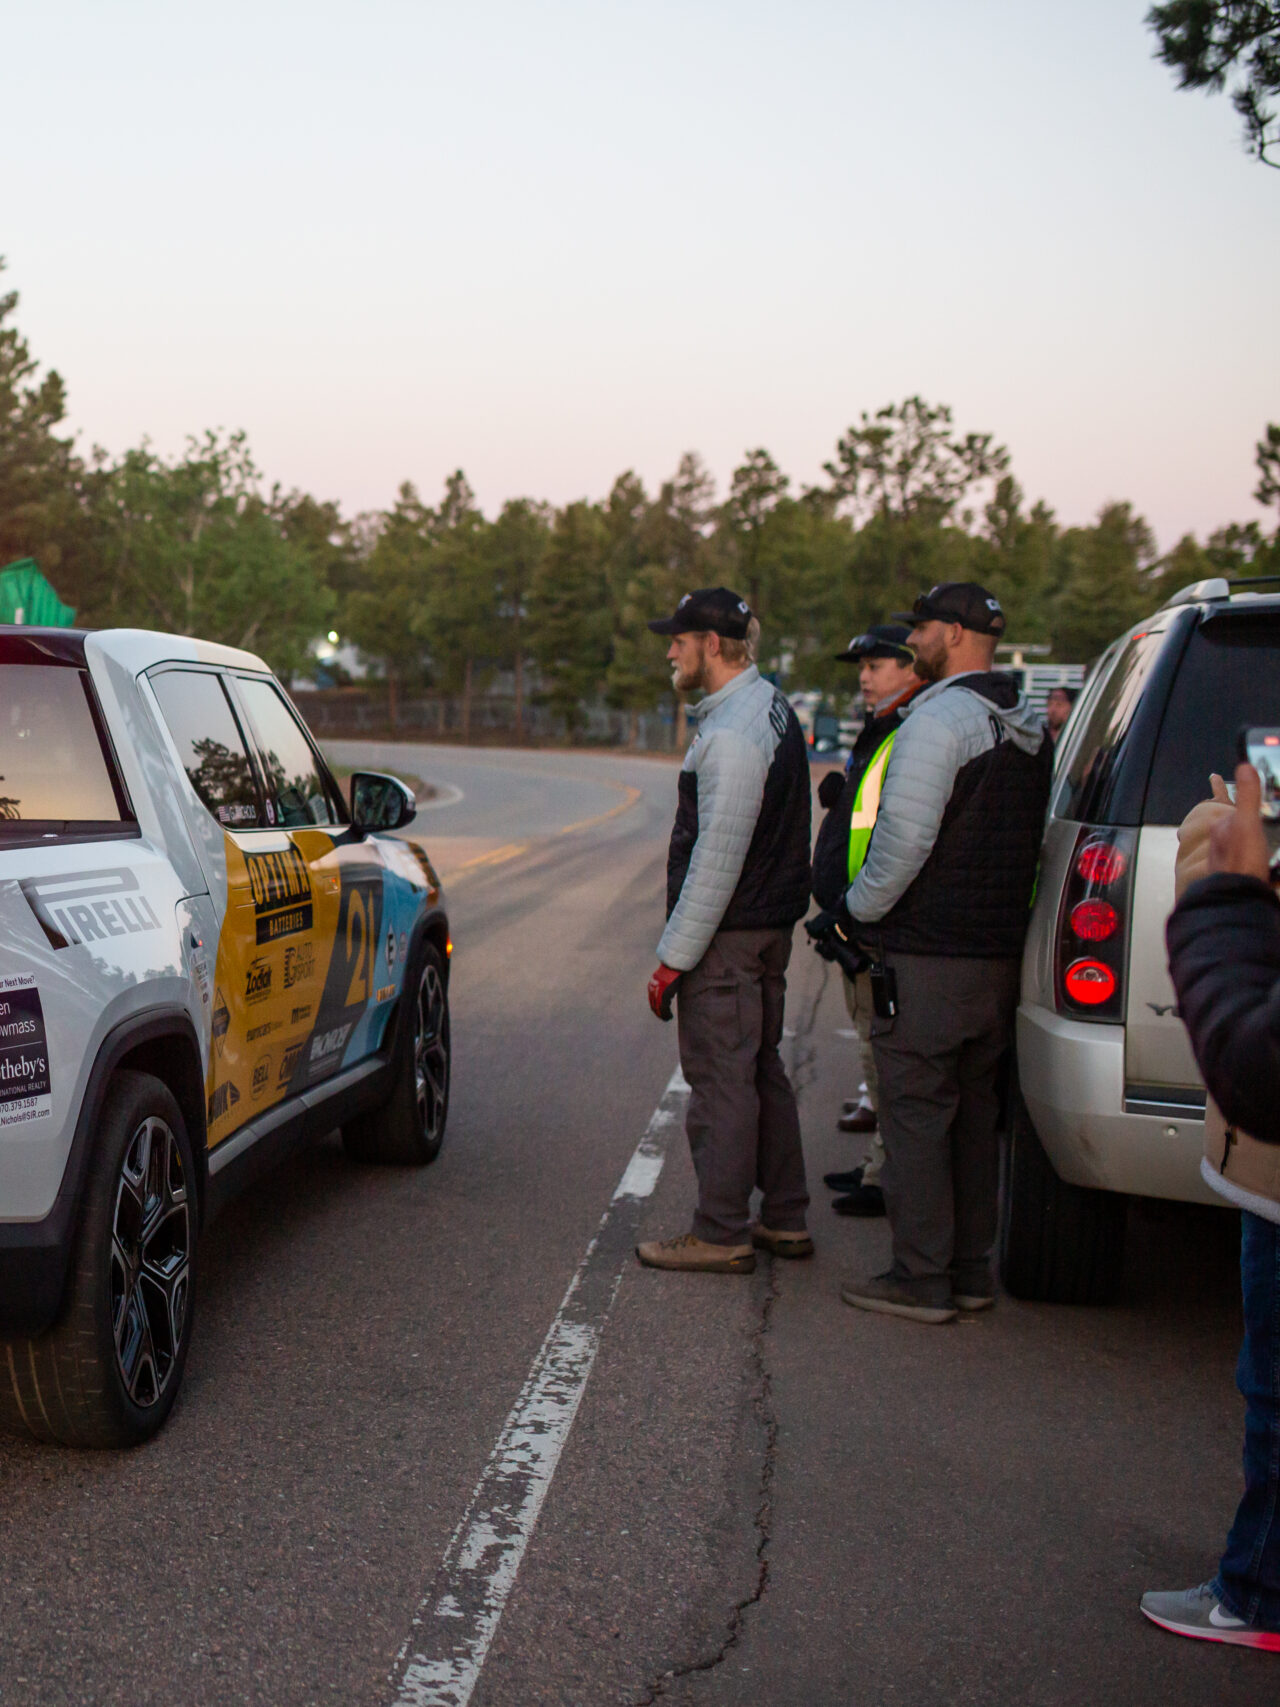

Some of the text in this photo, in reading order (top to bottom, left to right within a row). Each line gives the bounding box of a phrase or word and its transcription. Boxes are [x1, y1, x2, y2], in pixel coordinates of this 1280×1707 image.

[247, 850, 311, 906] OPTIMA
[17, 866, 163, 951] PIRELLI
[269, 911, 304, 937] BATTERIES
[344, 888, 375, 1008] 21
[4, 978, 18, 988] Next
[18, 975, 35, 985] Move?
[27, 1081, 47, 1092] REALTY
